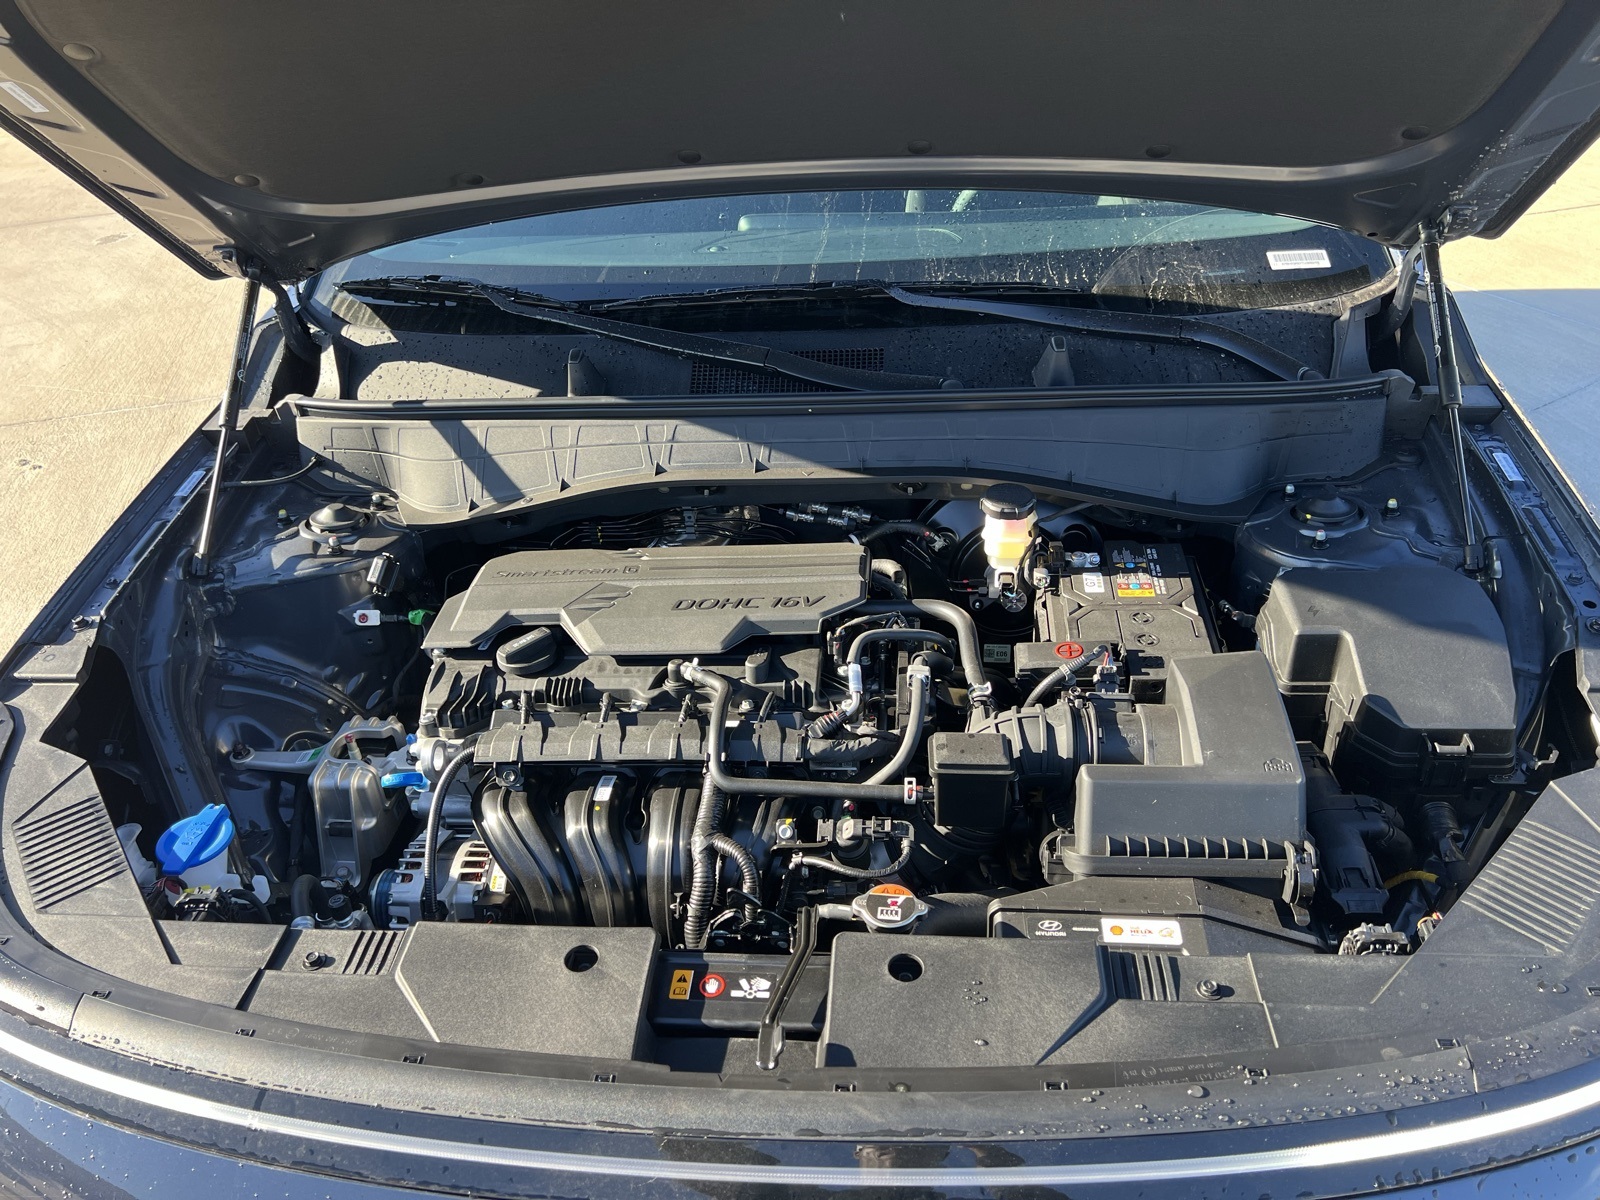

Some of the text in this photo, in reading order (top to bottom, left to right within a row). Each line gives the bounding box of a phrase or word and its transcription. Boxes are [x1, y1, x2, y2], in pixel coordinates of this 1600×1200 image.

[493, 568, 619, 578] Smartstream
[671, 595, 826, 611] DOHC 16V
